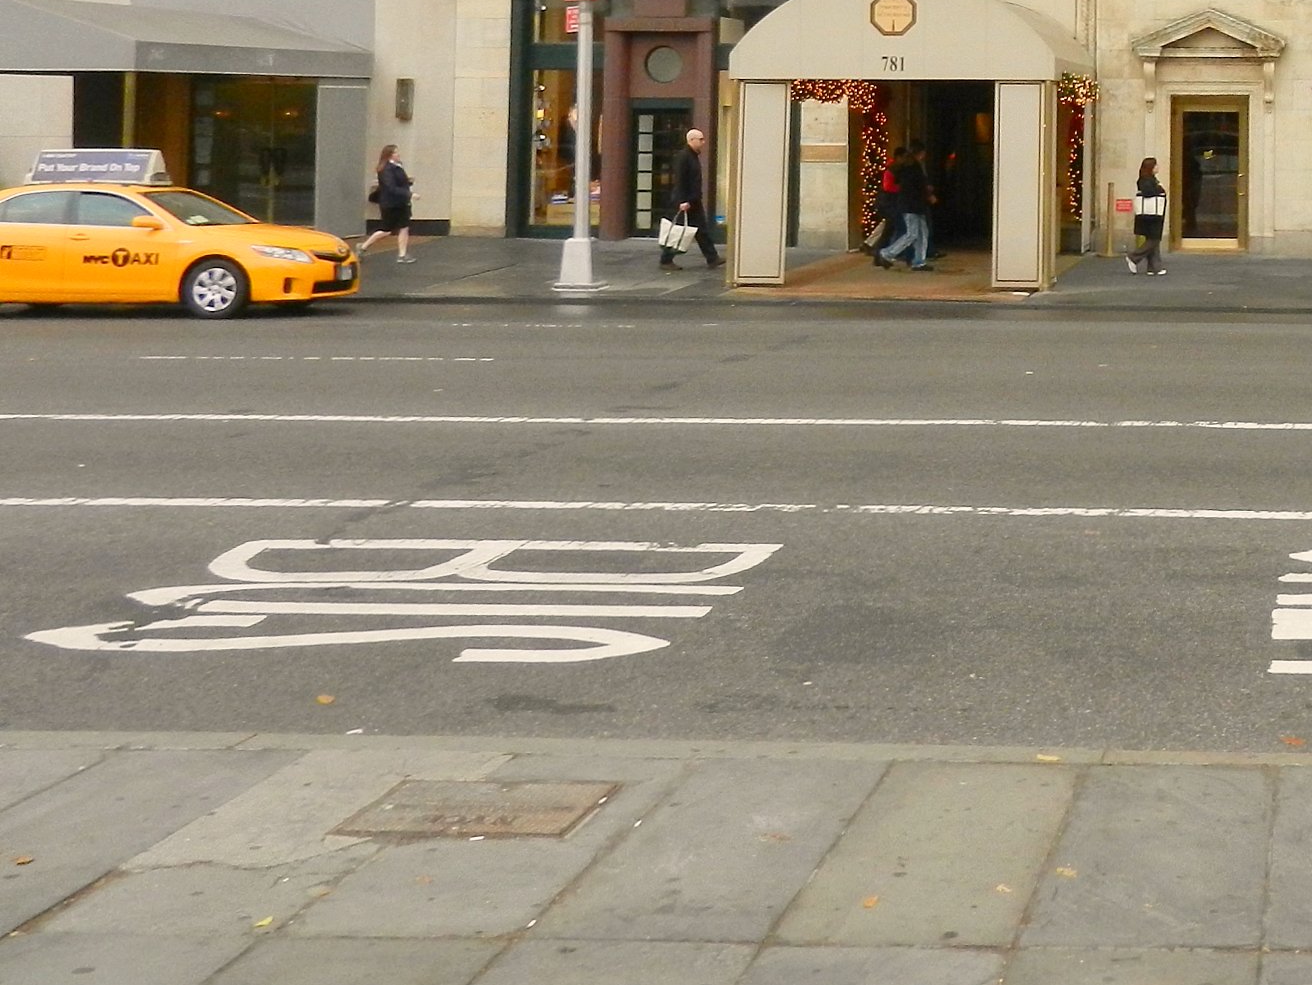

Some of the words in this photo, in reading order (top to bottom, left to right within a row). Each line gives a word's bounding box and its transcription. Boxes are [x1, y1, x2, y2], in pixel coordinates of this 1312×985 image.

[881, 56, 905, 71] 781
[38, 163, 55, 172] Put
[56, 163, 79, 172] Your
[79, 163, 108, 172] Brand
[109, 163, 123, 172] On
[124, 163, 141, 173] Top
[83, 255, 110, 264] NYC
[23, 536, 785, 664] BUS
